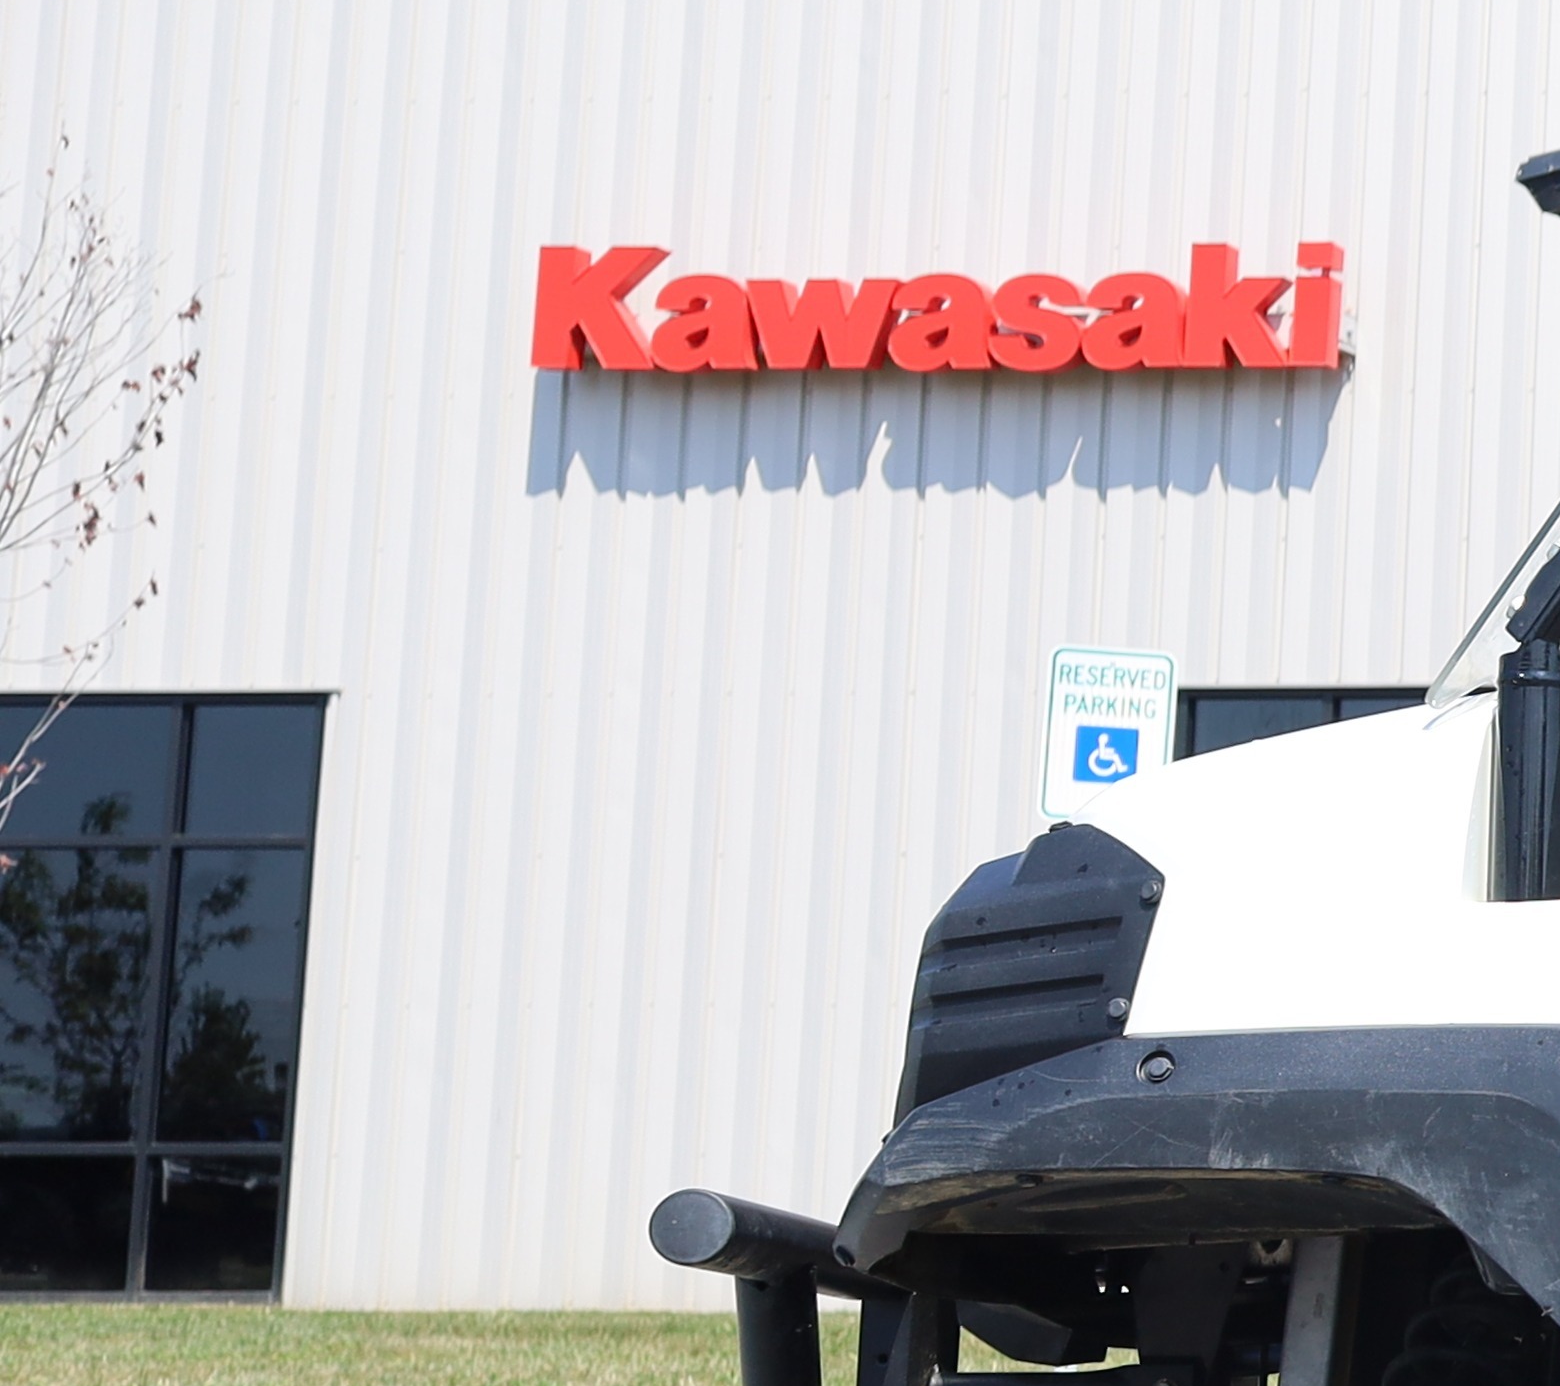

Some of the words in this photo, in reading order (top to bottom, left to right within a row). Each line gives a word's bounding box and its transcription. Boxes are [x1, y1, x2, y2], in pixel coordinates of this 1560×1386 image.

[531, 242, 1345, 373] Kawasaki
[1059, 663, 1166, 690] RESERVED
[1064, 694, 1156, 719] PARKING
